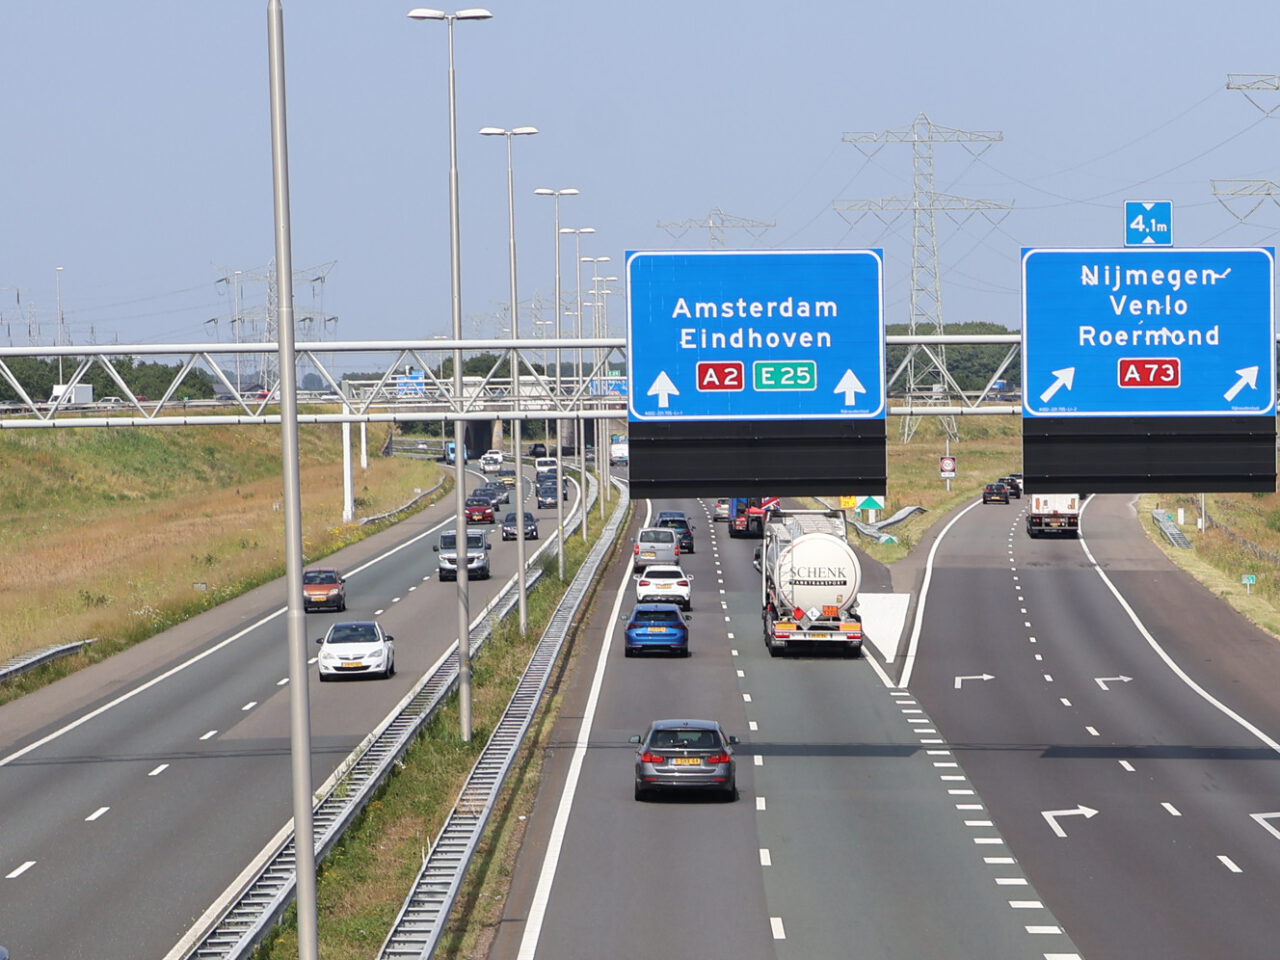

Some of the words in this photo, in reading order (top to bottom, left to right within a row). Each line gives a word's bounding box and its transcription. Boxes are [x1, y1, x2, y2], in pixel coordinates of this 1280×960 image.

[1081, 265, 1216, 291] Nijmegen
[672, 297, 838, 319] Amsterdam
[1110, 294, 1188, 316] Venlo
[679, 327, 831, 349] Eindhoven
[1079, 324, 1219, 346] Roermond
[702, 367, 739, 386] A2
[1124, 363, 1175, 382] A73
[790, 566, 846, 578] SCHENK
